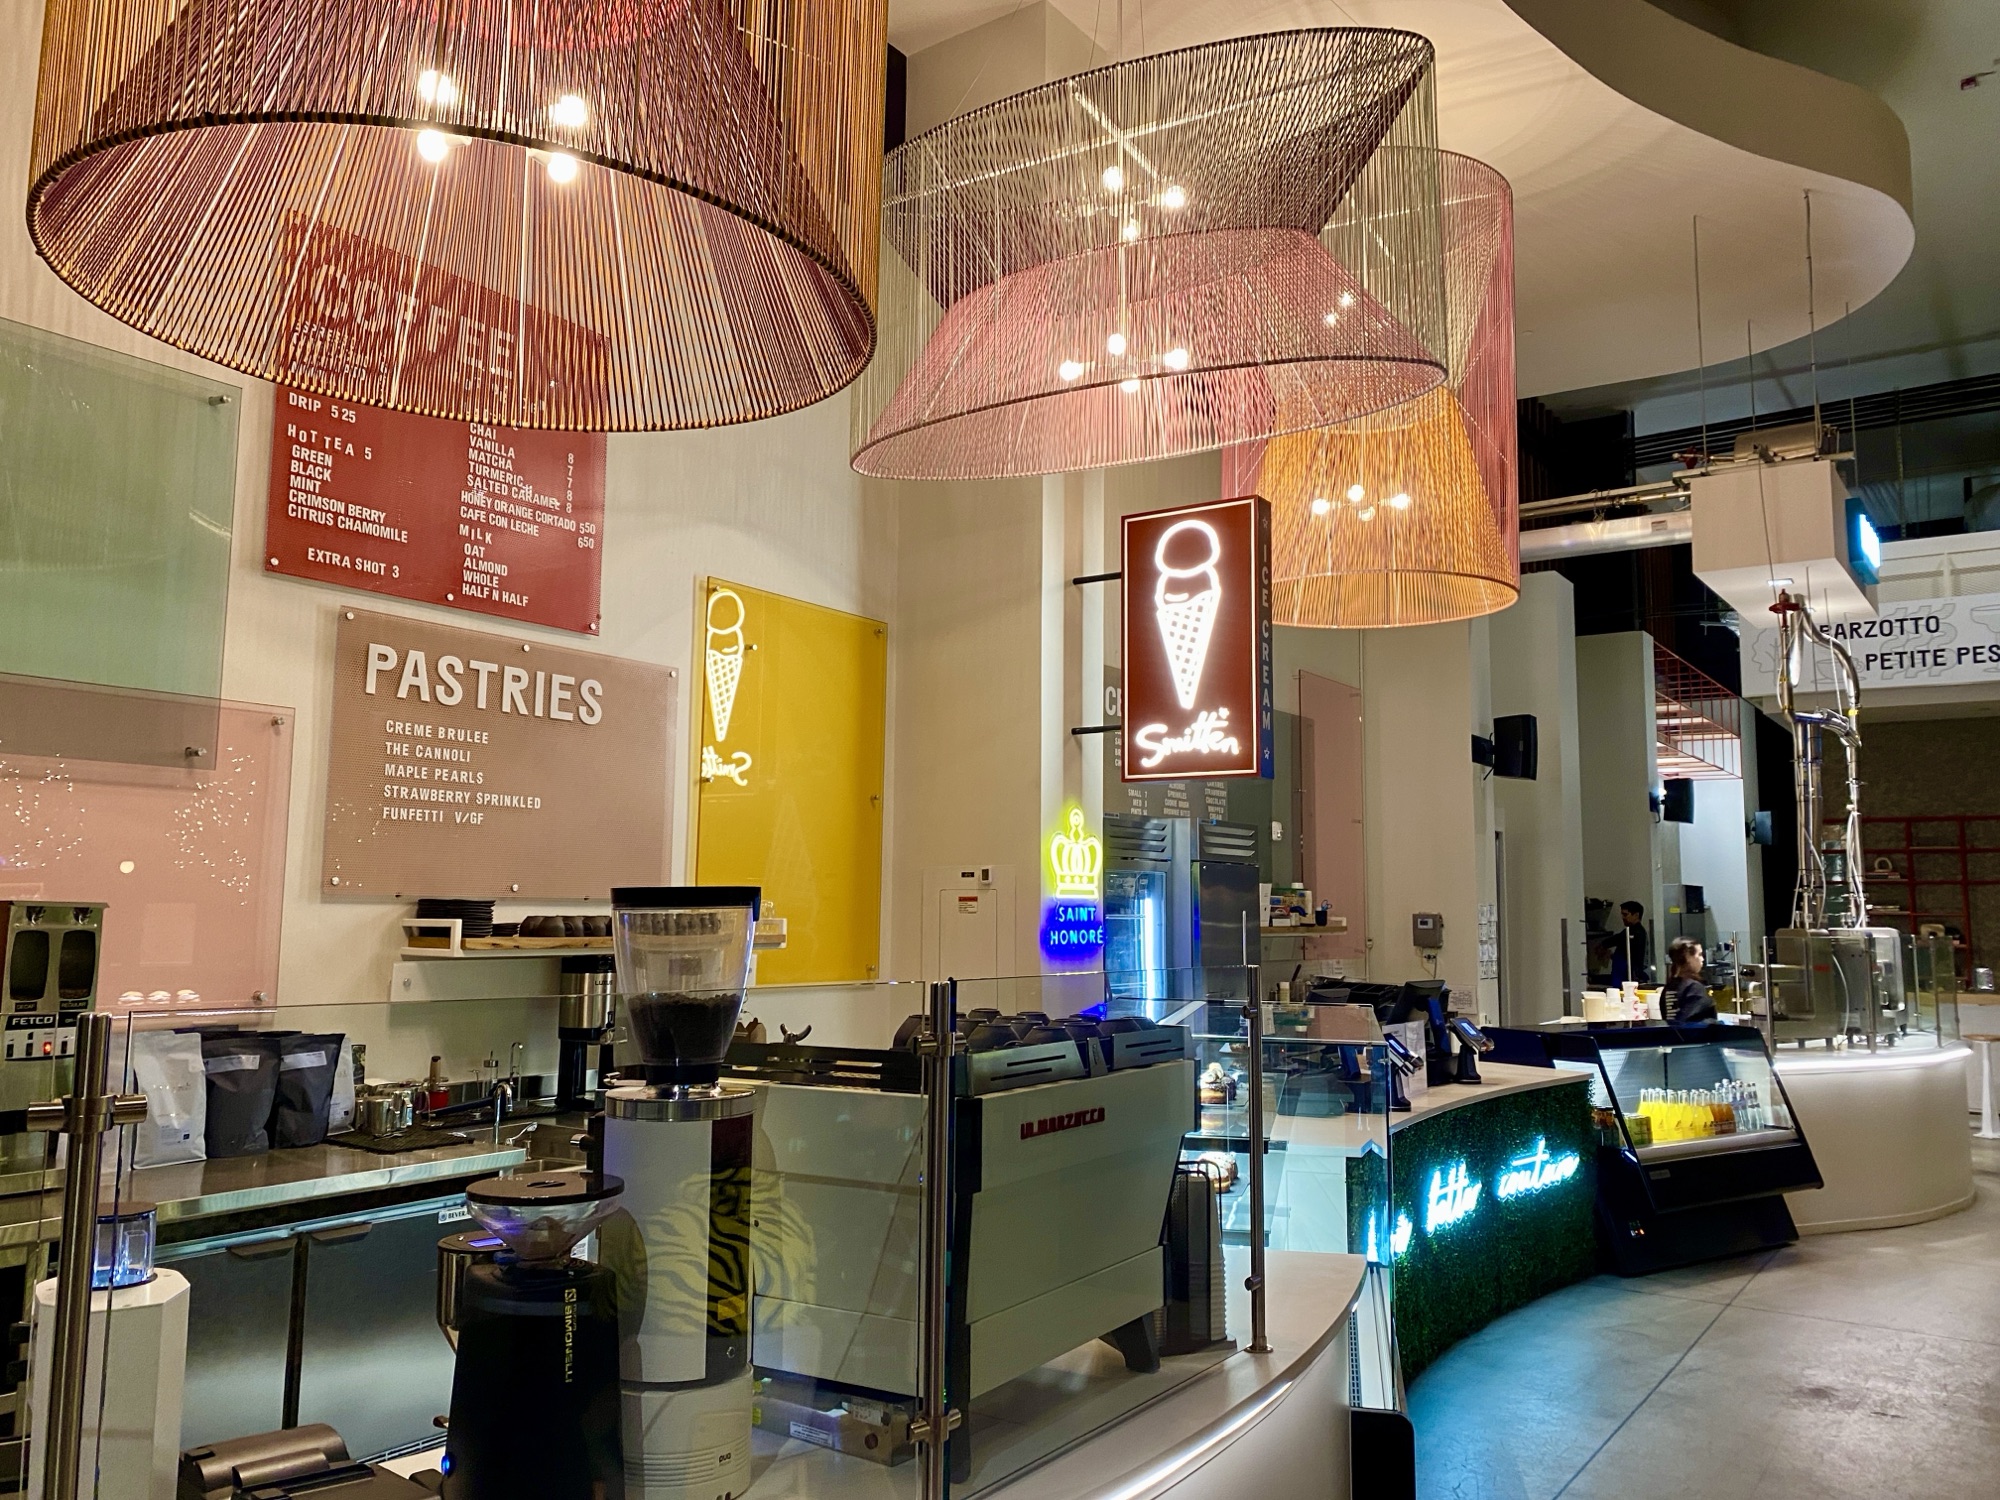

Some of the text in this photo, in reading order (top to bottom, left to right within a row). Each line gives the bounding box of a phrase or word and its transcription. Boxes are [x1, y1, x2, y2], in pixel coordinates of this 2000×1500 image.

[289, 392, 321, 412] DRIP
[288, 424, 372, 460] HOT TEA 5
[470, 422, 574, 464] CHAI 8
[292, 444, 332, 467] GREEN
[470, 435, 574, 476] VANILLA 7
[290, 460, 332, 482] BLACK
[468, 448, 573, 488] MATCHA 7
[290, 474, 322, 494] MINT
[468, 461, 572, 502] TURMERIC 8
[467, 474, 572, 514] SALTED CARAMEL 8
[289, 489, 386, 524] CRIMSON BERRY
[461, 490, 492, 509] HONEY
[494, 500, 534, 520] ORANGE
[536, 510, 576, 532] CORTADO
[288, 504, 408, 543] CITRUS CHAMOMILE
[460, 506, 486, 522] CAFE
[488, 513, 508, 529] CON
[510, 518, 540, 537] LECHE
[459, 524, 492, 545] MILK
[464, 543, 485, 558] OAT
[308, 548, 400, 578] EXTRA SHOT 3
[464, 558, 508, 576] ALMOND
[462, 570, 499, 588] WHOLE
[462, 583, 529, 607] HALF N HALF
[1261, 544, 1270, 730] ICE CREAM
[1865, 649, 1947, 671] PETITE
[365, 642, 604, 726] PASTRIES
[386, 720, 489, 744] CREME BRULEE
[1135, 709, 1239, 767] Smitten
[385, 742, 471, 763] THE CANNOLI
[384, 764, 484, 784] MAPLE PEARLS
[383, 784, 542, 810] STRAWBERRY SPRINKLED
[1128, 788, 1142, 798] SMALL
[382, 807, 484, 826] FUNFETTI V/GF
[1058, 906, 1096, 922] SAINT
[1050, 926, 1104, 946] HONORÉ
[12, 1016, 54, 1026] FETCO
